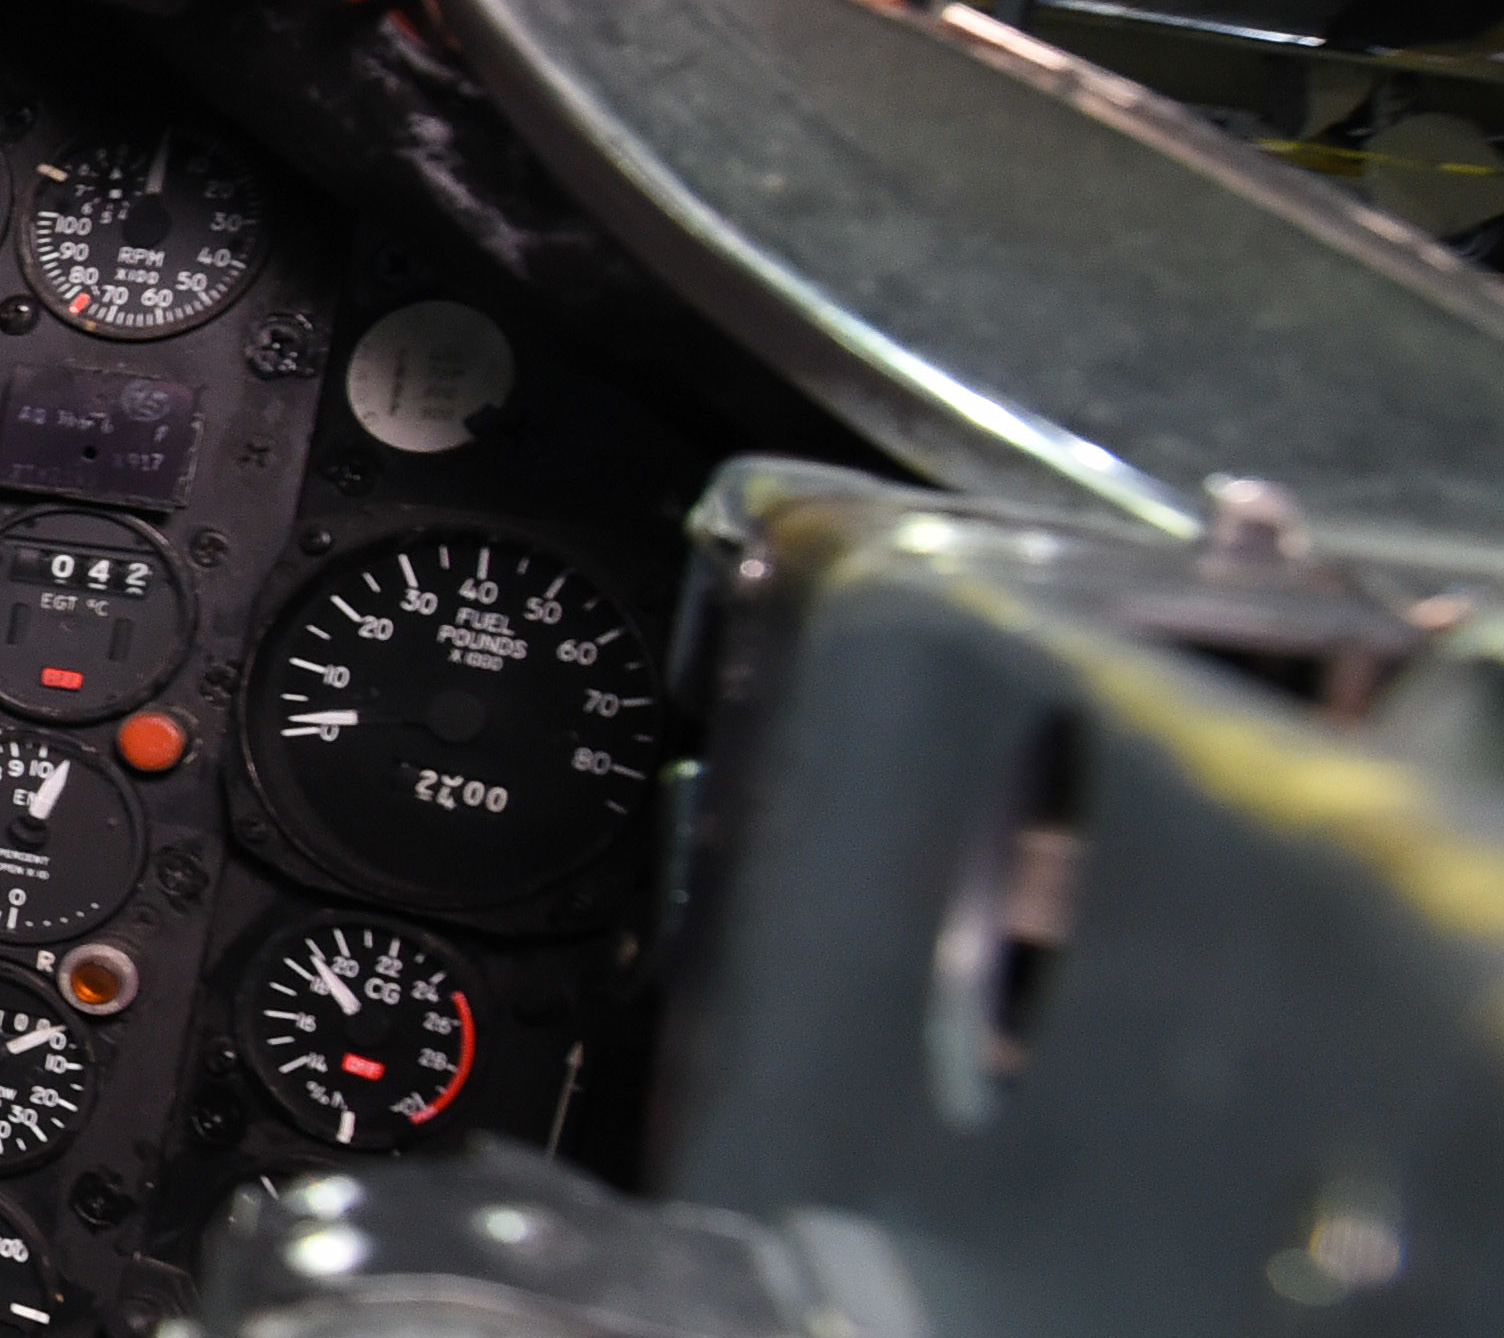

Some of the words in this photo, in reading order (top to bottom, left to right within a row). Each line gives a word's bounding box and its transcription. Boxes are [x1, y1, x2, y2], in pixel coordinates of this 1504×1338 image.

[459, 579, 498, 604] 40
[456, 607, 514, 635] FUEL
[437, 624, 527, 660] POUNDS
[557, 640, 597, 665] 60
